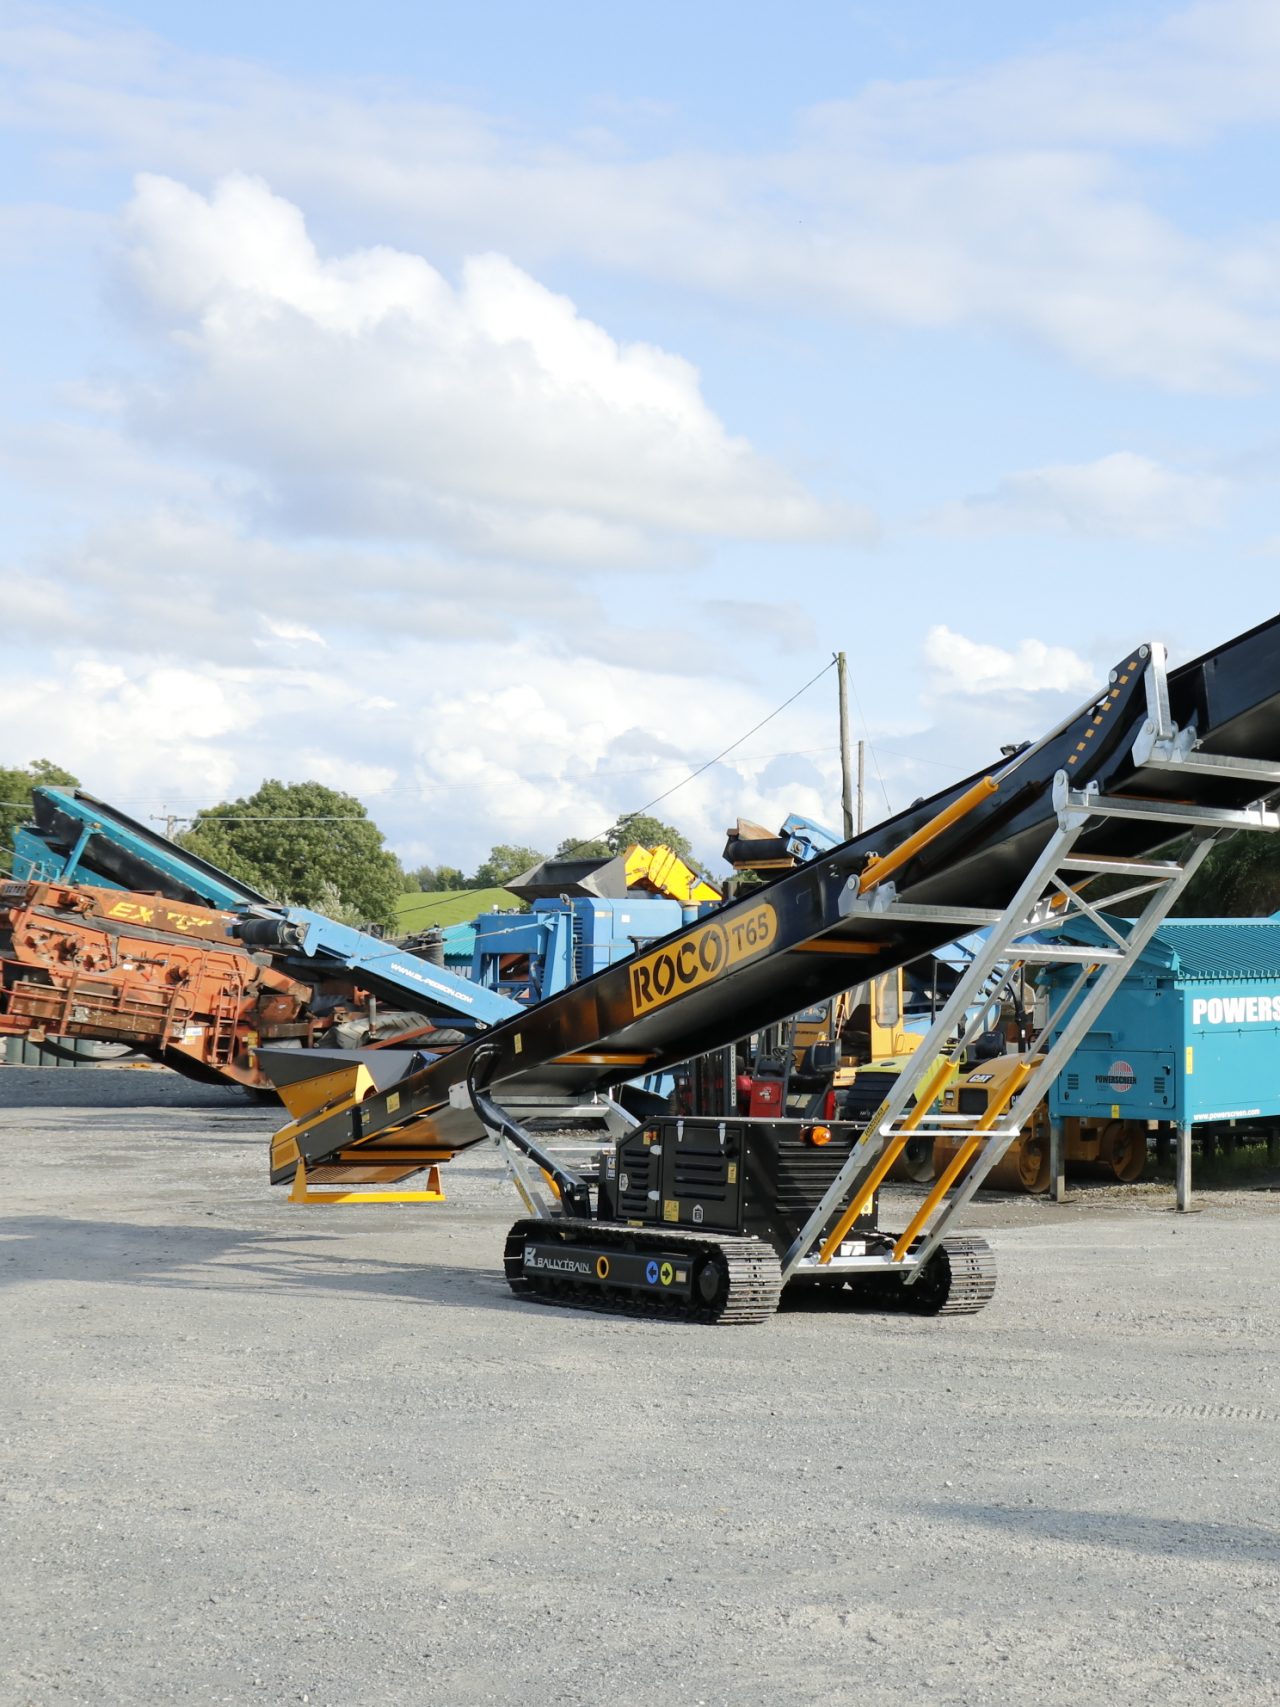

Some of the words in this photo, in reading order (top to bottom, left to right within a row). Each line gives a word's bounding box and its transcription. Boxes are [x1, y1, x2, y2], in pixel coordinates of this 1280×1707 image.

[633, 930, 723, 1009] ROCO
[732, 912, 769, 952] T65
[1095, 1075, 1137, 1085] POWERSCREEN
[1193, 1108, 1261, 1121] www.powerscreen.com
[537, 1257, 592, 1274] BALLYTRAIN
